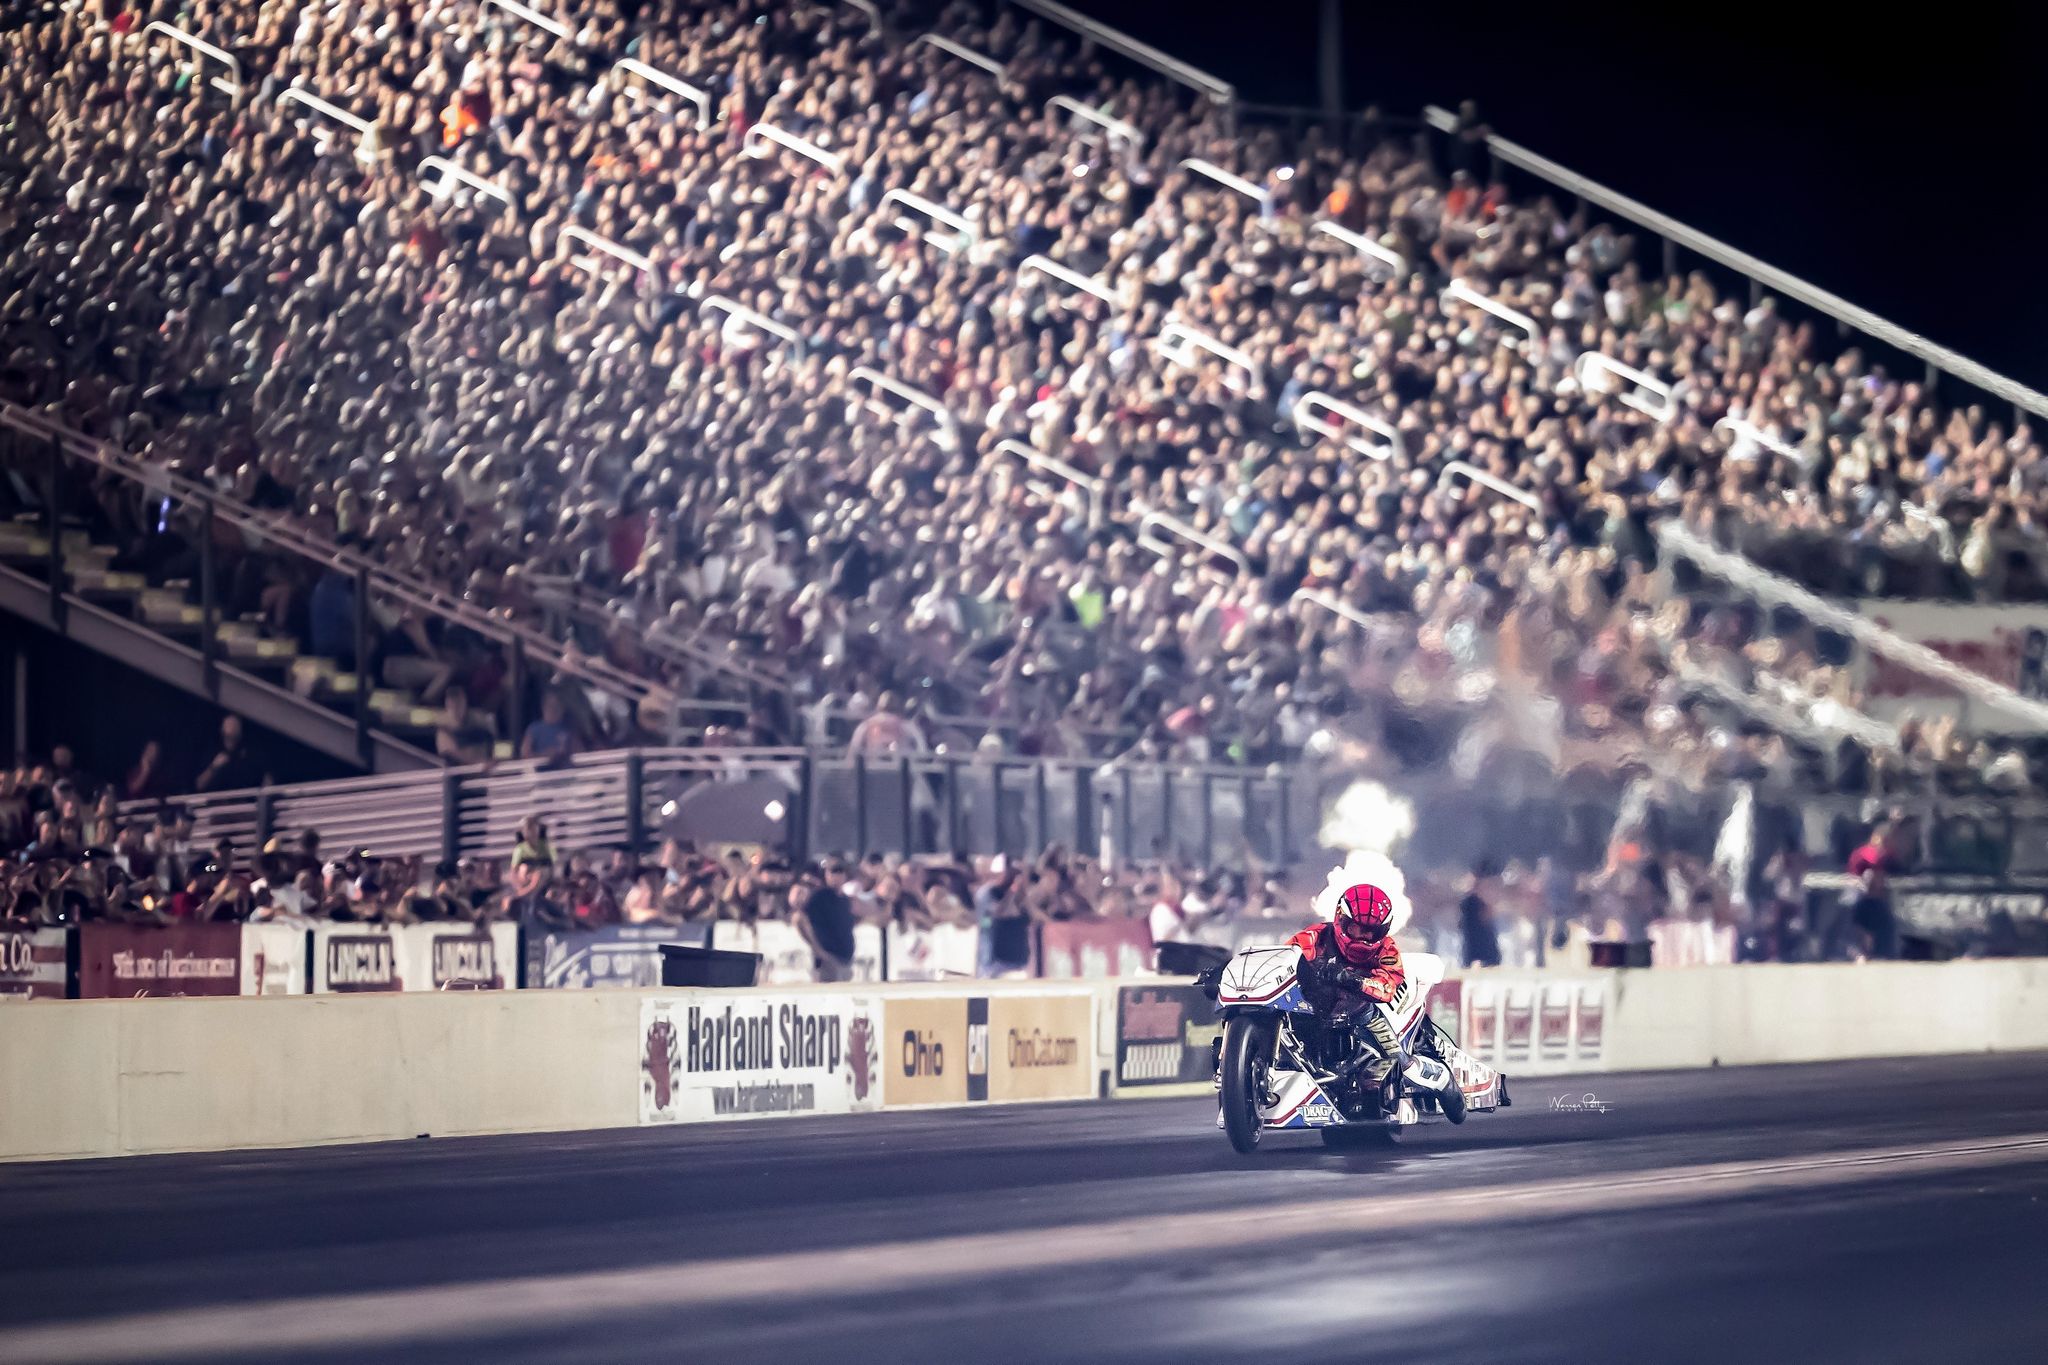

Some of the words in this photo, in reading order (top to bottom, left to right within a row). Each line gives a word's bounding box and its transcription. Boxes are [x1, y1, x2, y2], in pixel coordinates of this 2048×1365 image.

[687, 1005, 772, 1073] Harland
[779, 1003, 841, 1074] Sharp
[903, 1030, 944, 1077] Ohio
[1303, 1105, 1330, 1118] DRAG
